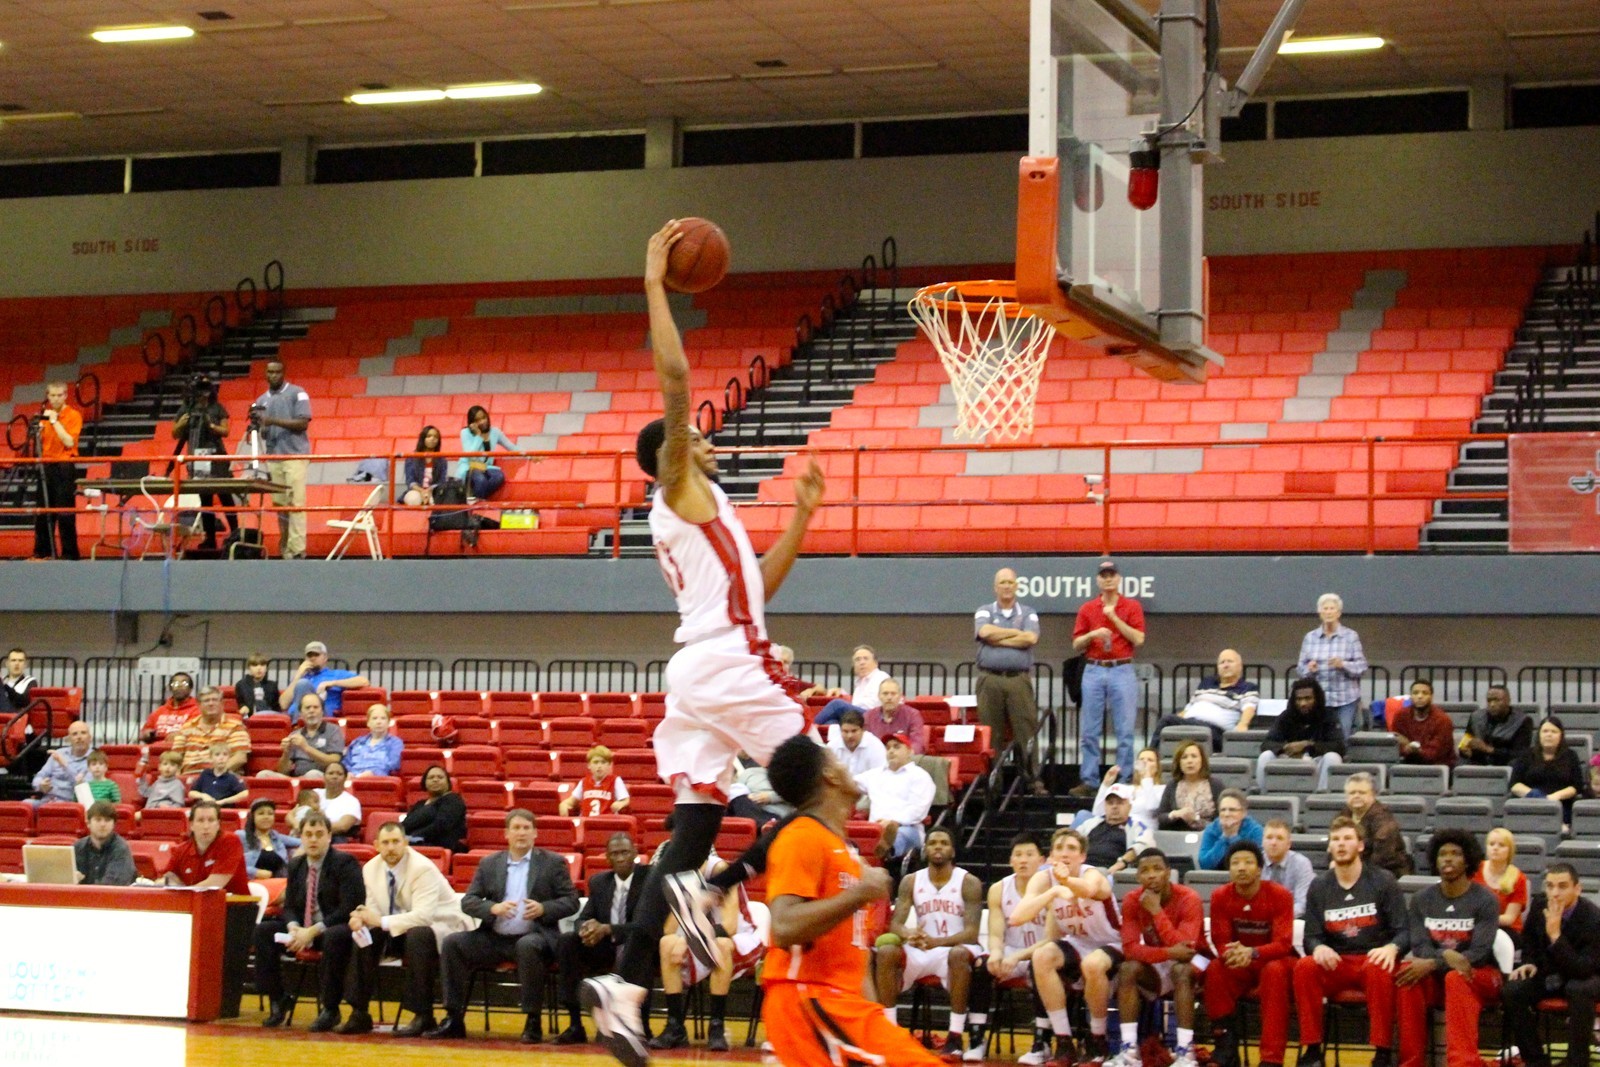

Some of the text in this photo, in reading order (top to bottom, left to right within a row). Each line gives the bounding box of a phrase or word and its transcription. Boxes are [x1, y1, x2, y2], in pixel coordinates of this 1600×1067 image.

[1209, 191, 1321, 210] SOUTH SIDE
[72, 239, 159, 255] SOUTH SIDE
[1016, 576, 1155, 598] SOUTH IDE
[589, 799, 601, 817] 3
[1324, 902, 1378, 922] NICHOLLS
[934, 919, 948, 938] 14
[1424, 916, 1475, 932] NICHOLLS
